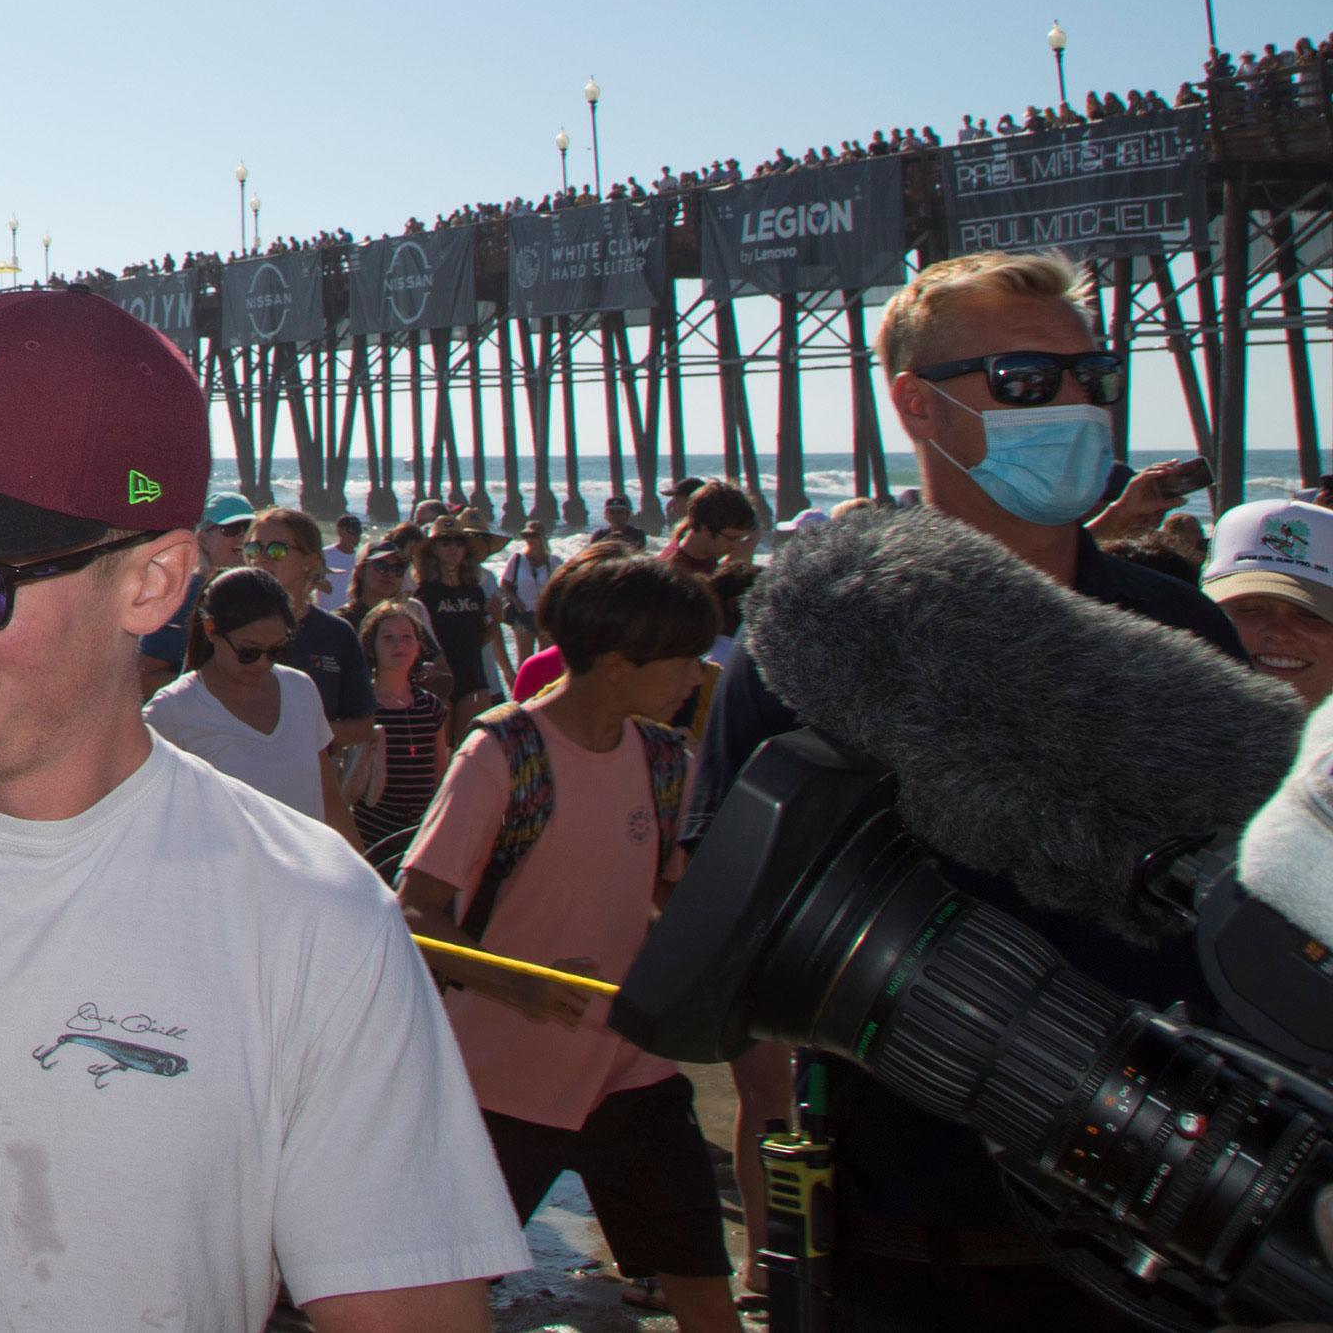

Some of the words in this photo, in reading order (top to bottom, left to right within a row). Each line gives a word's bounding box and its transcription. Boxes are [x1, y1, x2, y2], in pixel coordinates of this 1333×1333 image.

[957, 159, 1026, 191] PAUL
[1032, 132, 1180, 180] MITCHELL
[741, 199, 853, 243] LEGION
[961, 220, 1028, 251] PAUL
[1033, 201, 1183, 242] MITCHELL
[551, 242, 600, 262] WHITE
[608, 237, 651, 257] CLAW
[741, 250, 753, 265] by
[755, 246, 797, 261] Lenovo
[384, 273, 433, 290] NISSAN
[551, 265, 585, 280] HARD
[593, 258, 646, 276] SELTZER
[121, 292, 193, 329] OLYN
[246, 292, 292, 309] NISSAN
[886, 968, 908, 997] MADE
[904, 955, 916, 967] IN
[915, 927, 937, 955] JAPAN
